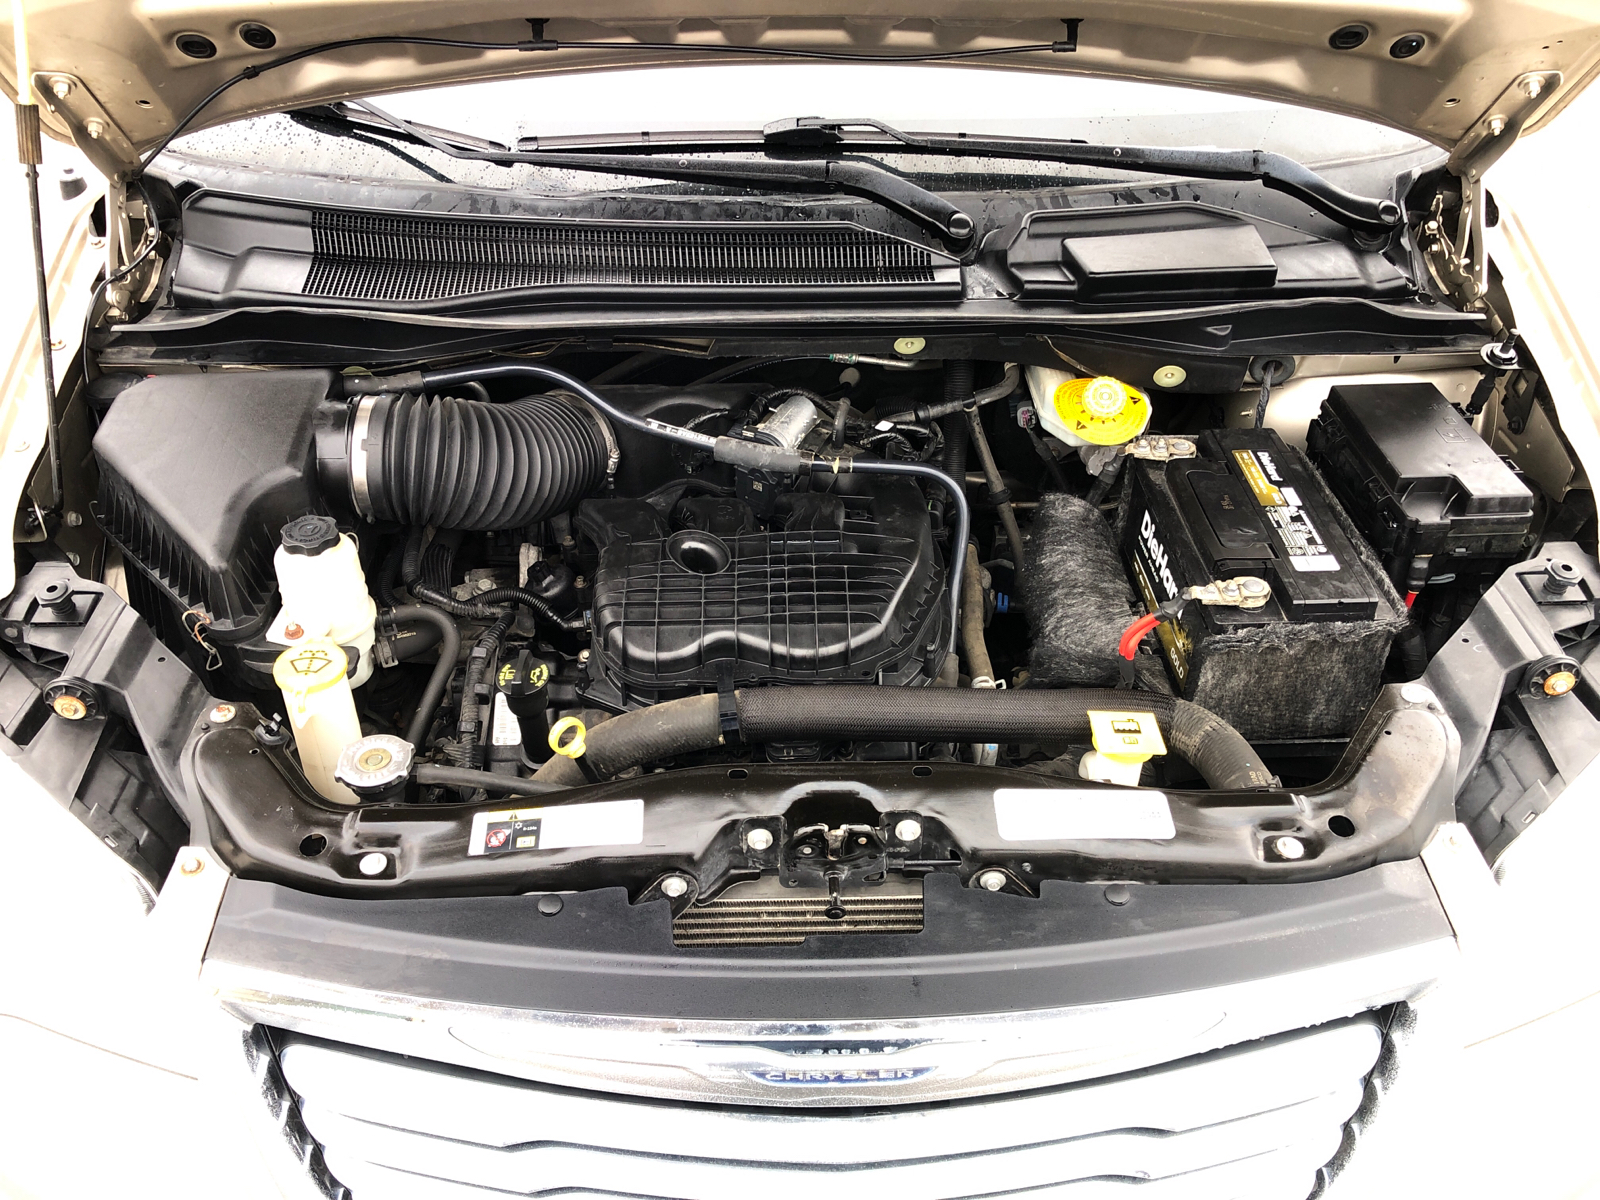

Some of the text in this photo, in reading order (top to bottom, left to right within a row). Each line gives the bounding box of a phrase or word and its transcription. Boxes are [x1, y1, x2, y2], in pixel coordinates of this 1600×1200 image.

[1140, 509, 1184, 620] DieHar
[1170, 647, 1185, 679] GOLD
[765, 1069, 914, 1081] CHRYSLER
